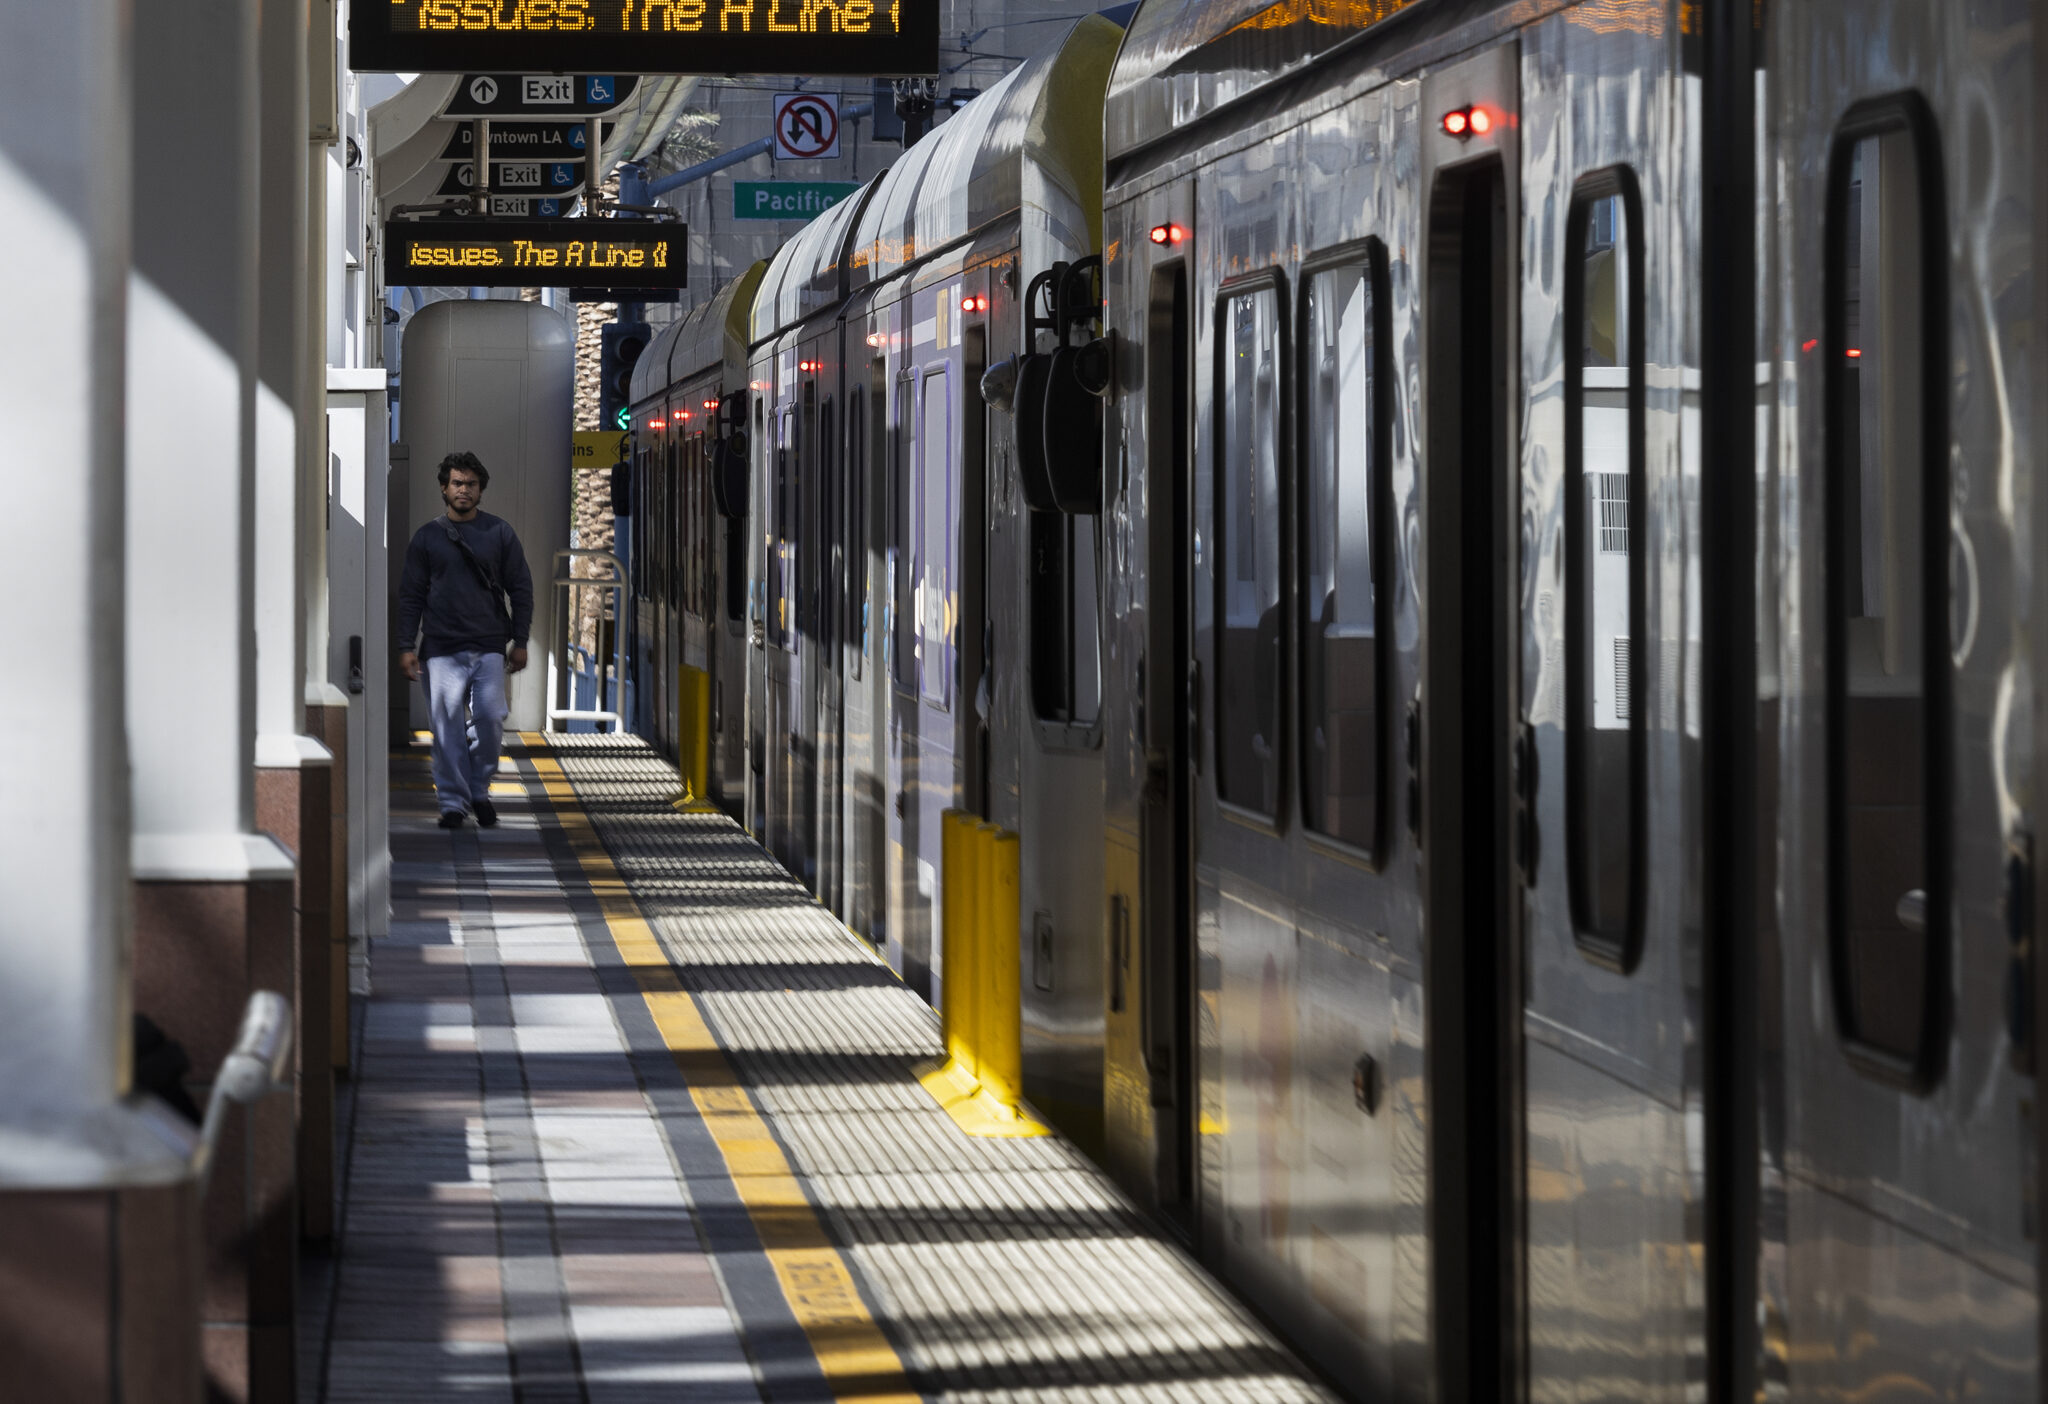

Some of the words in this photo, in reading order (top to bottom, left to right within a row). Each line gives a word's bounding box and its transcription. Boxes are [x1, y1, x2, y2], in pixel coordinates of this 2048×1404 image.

[527, 81, 570, 100] Exit
[463, 130, 538, 144] Dntown
[543, 130, 562, 144] LA
[503, 168, 538, 183] Exit
[494, 200, 526, 213] Exit
[755, 190, 834, 211] Pacific
[513, 240, 559, 266] The
[565, 241, 583, 266] A
[590, 241, 645, 267] Line
